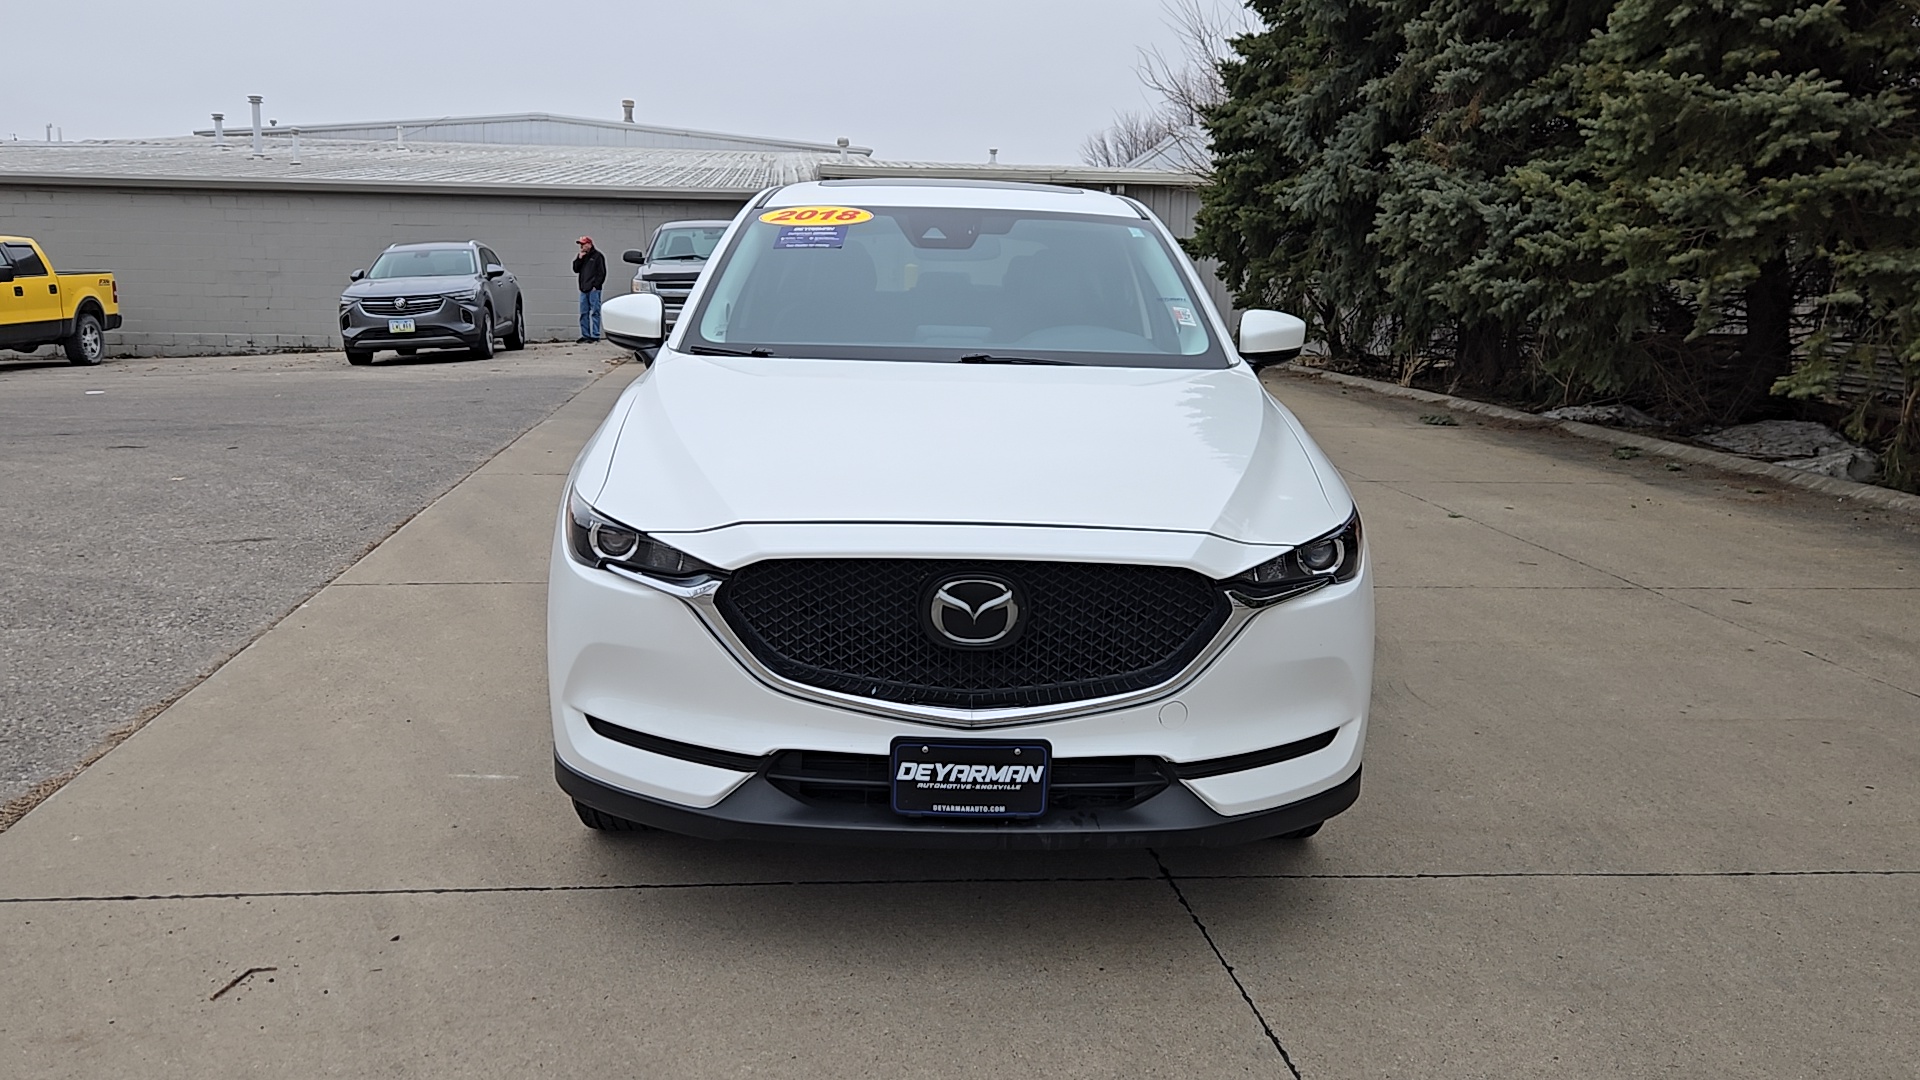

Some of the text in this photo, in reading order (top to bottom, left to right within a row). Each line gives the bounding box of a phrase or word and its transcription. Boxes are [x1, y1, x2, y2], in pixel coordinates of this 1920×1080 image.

[770, 210, 861, 221] 2018
[895, 762, 1045, 783] DEYARMAN
[933, 804, 1006, 812] DEYARMANAUTO.COM
